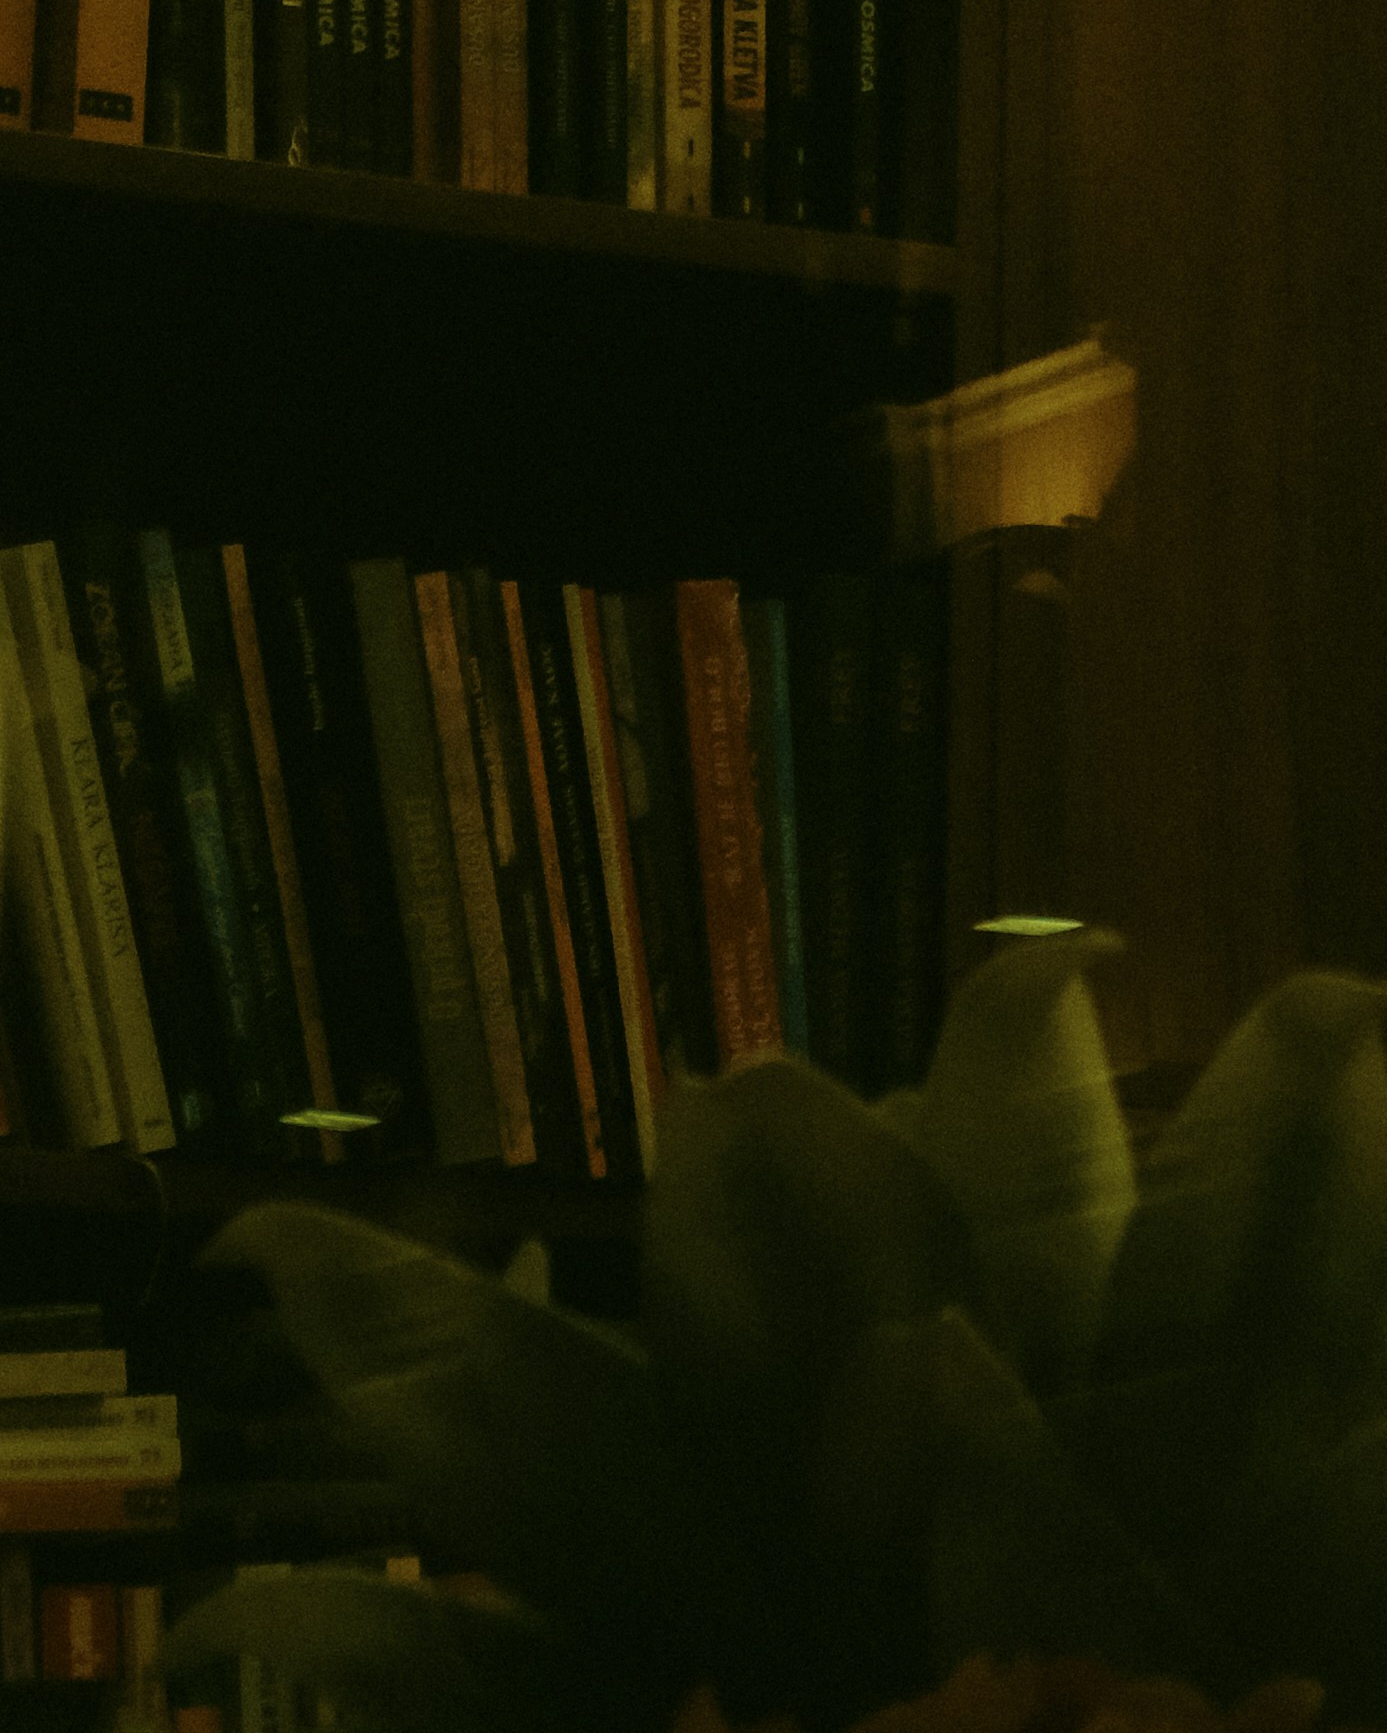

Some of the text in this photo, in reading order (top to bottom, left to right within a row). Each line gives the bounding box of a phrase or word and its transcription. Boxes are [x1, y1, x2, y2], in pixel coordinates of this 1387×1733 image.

[731, 18, 760, 102] KLETVA
[84, 581, 127, 693] ZORAN
[69, 736, 130, 959] KLARA KLARISA
